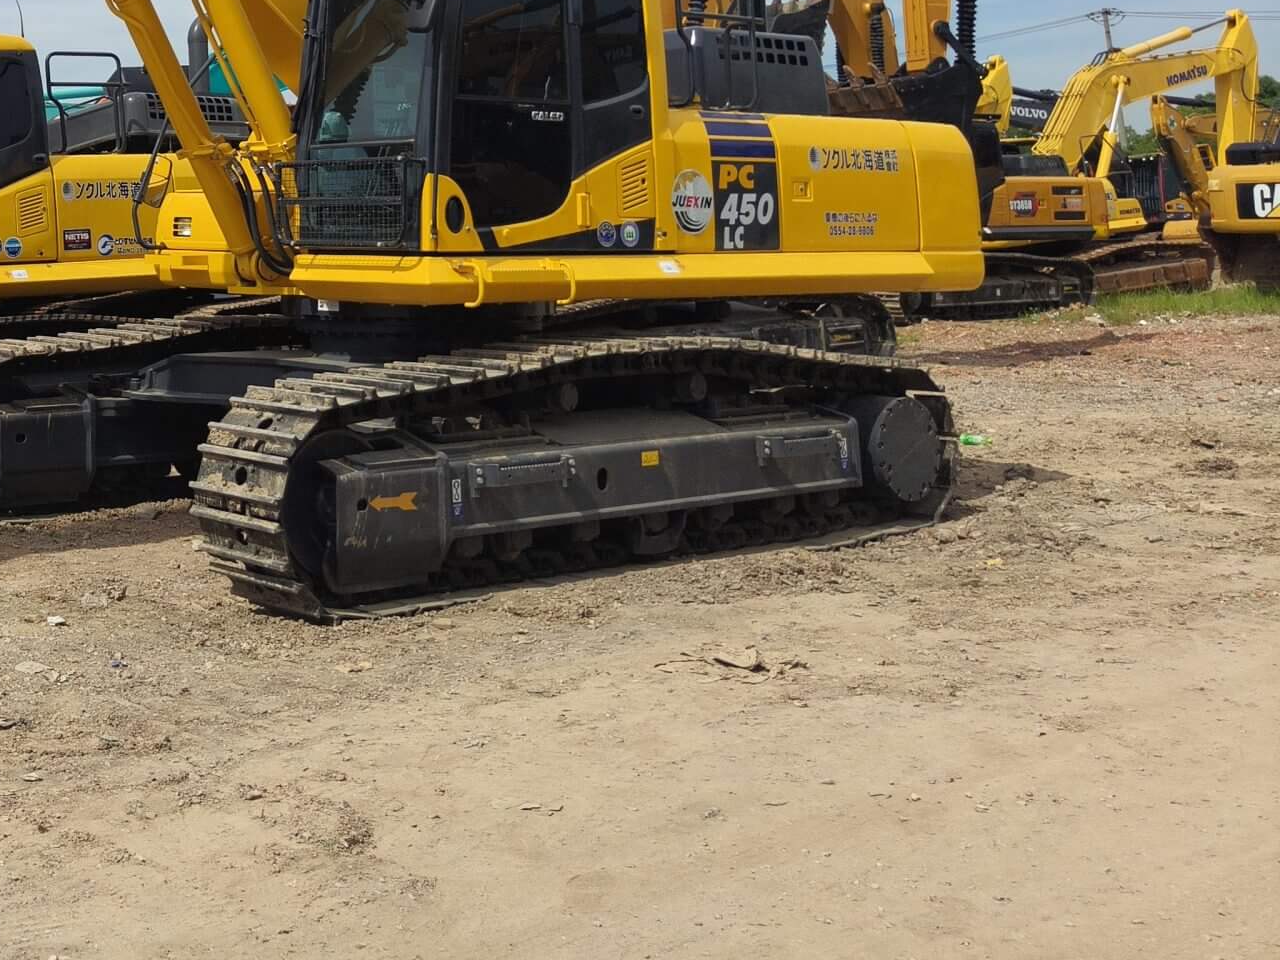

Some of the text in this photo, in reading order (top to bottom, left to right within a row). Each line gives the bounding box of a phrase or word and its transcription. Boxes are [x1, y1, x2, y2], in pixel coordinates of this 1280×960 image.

[1167, 65, 1208, 87] KOMATSU
[1010, 105, 1048, 120] VOLVO
[718, 164, 754, 190] PC
[672, 195, 712, 209] JUEXIN
[720, 192, 775, 225] 450
[723, 226, 745, 249] LC
